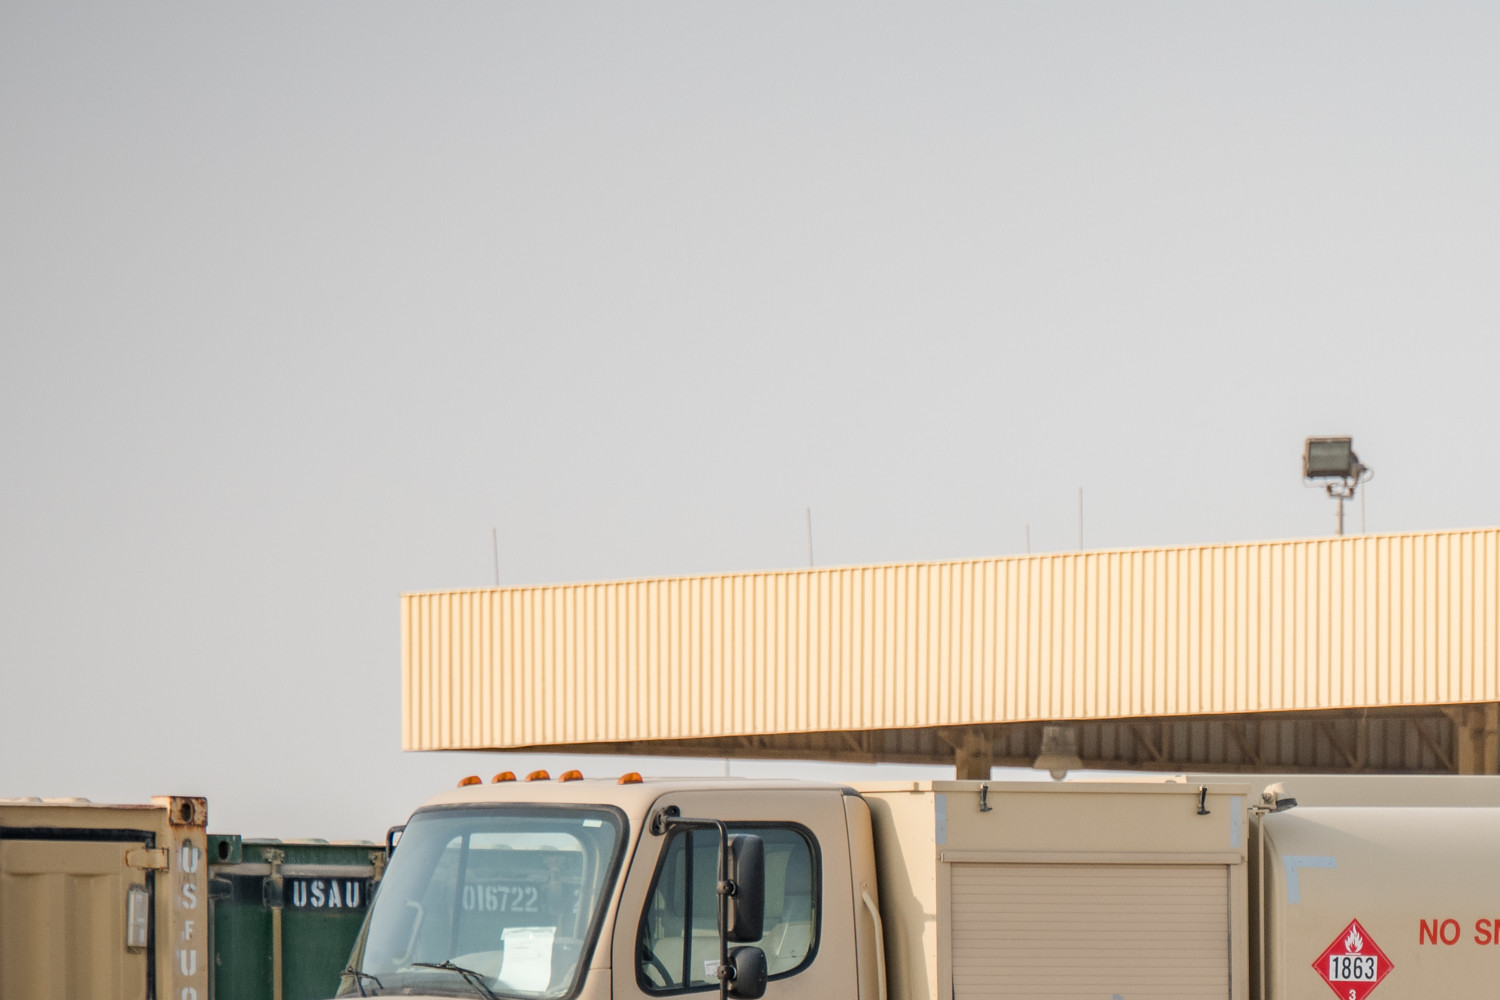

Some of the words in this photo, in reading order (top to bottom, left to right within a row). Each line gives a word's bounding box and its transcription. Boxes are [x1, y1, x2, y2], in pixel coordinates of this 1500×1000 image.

[293, 879, 360, 908] USAU
[463, 885, 538, 912] 016722
[1418, 918, 1461, 946] NO
[1332, 956, 1375, 980] 1863
